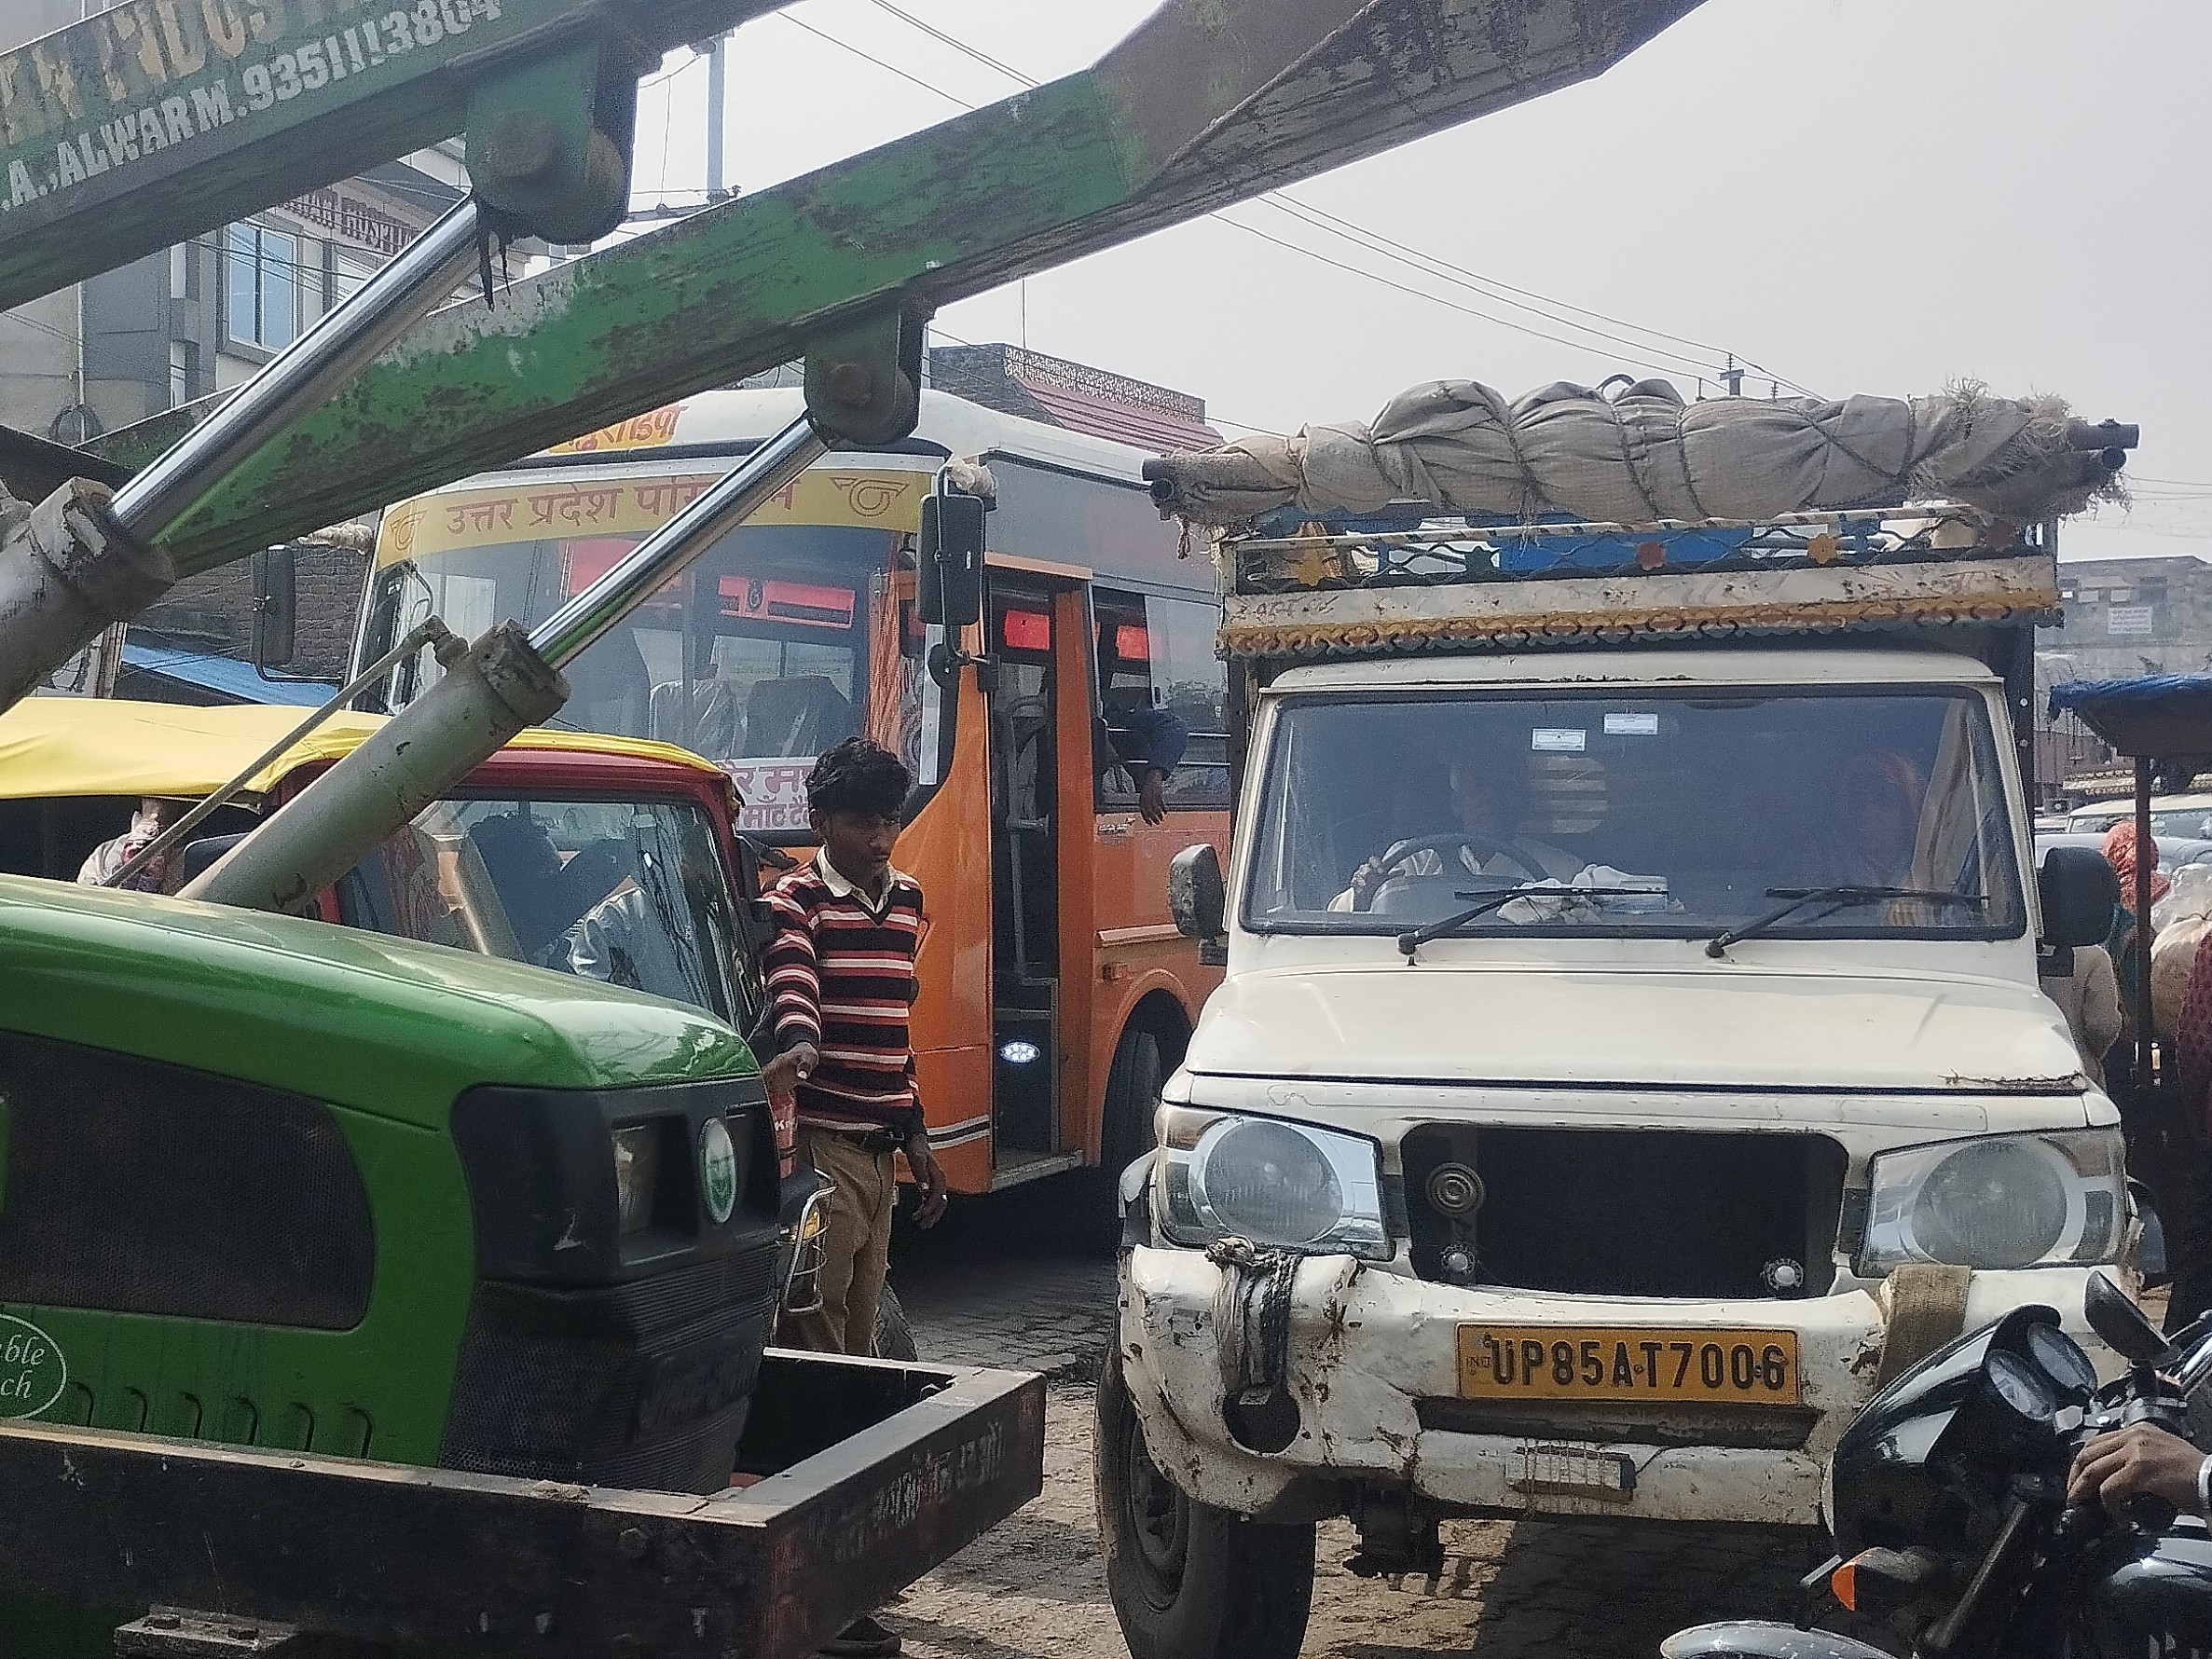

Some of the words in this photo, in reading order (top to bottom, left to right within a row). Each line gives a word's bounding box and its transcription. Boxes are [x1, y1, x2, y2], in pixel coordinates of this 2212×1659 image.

[447, 498, 519, 535] उत्तर
[528, 483, 624, 528] प्रदेश
[1491, 1338, 1786, 1390] UP85AT7006
